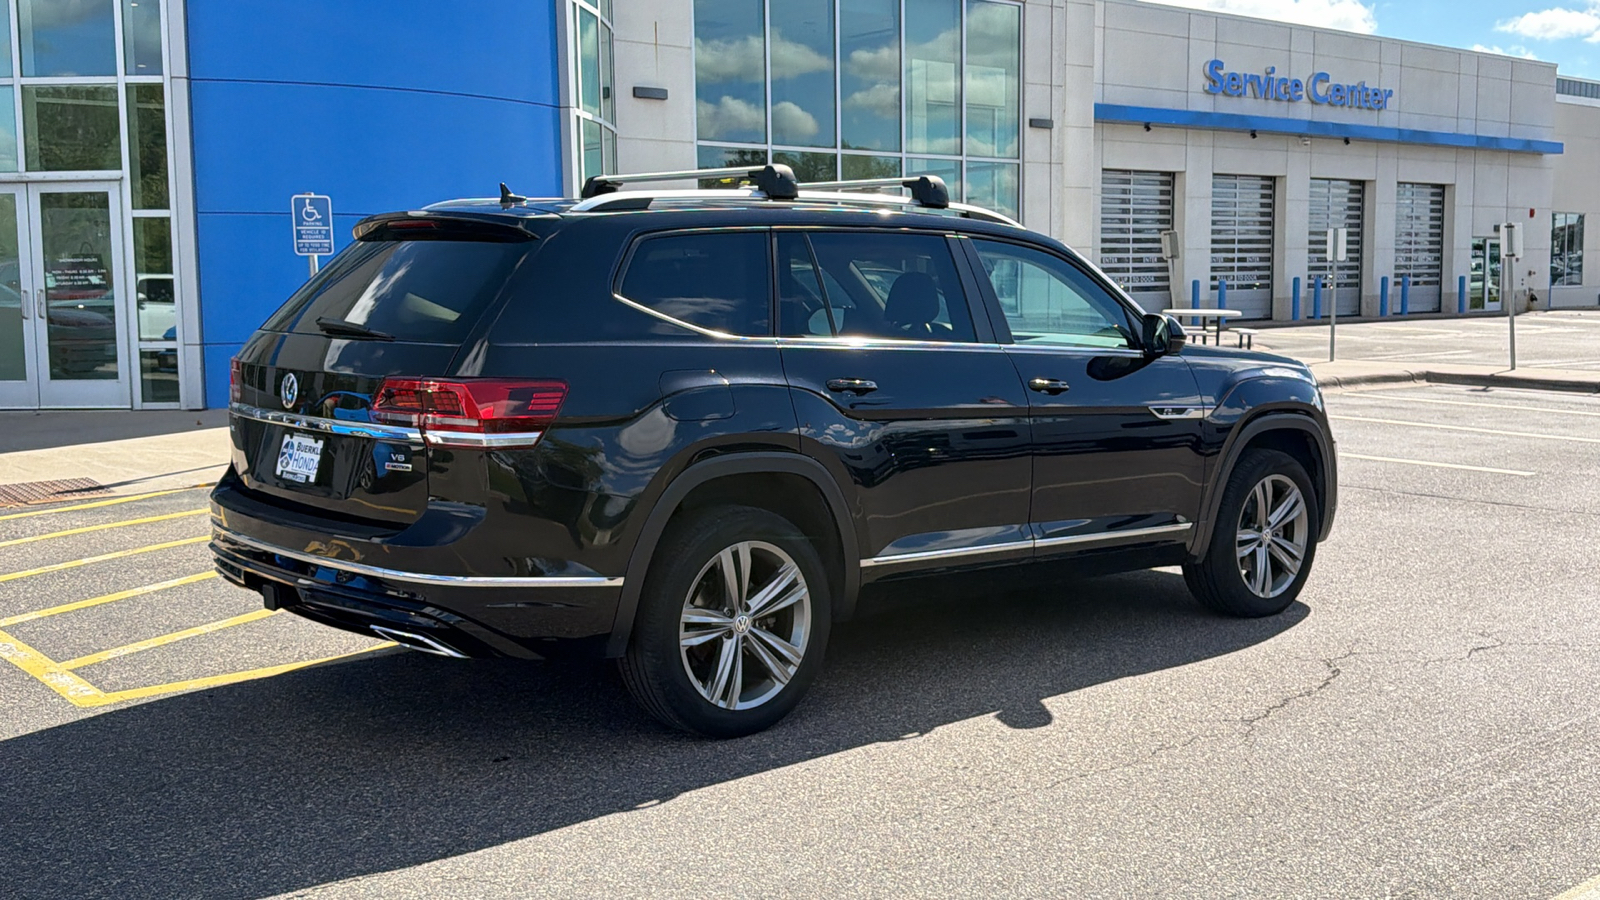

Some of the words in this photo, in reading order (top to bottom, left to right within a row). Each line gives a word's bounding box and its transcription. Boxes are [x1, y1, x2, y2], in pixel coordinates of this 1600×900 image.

[1203, 59, 1304, 101] Service
[1307, 71, 1394, 110] Center
[296, 441, 320, 456] BUERKL
[390, 453, 405, 462] V6
